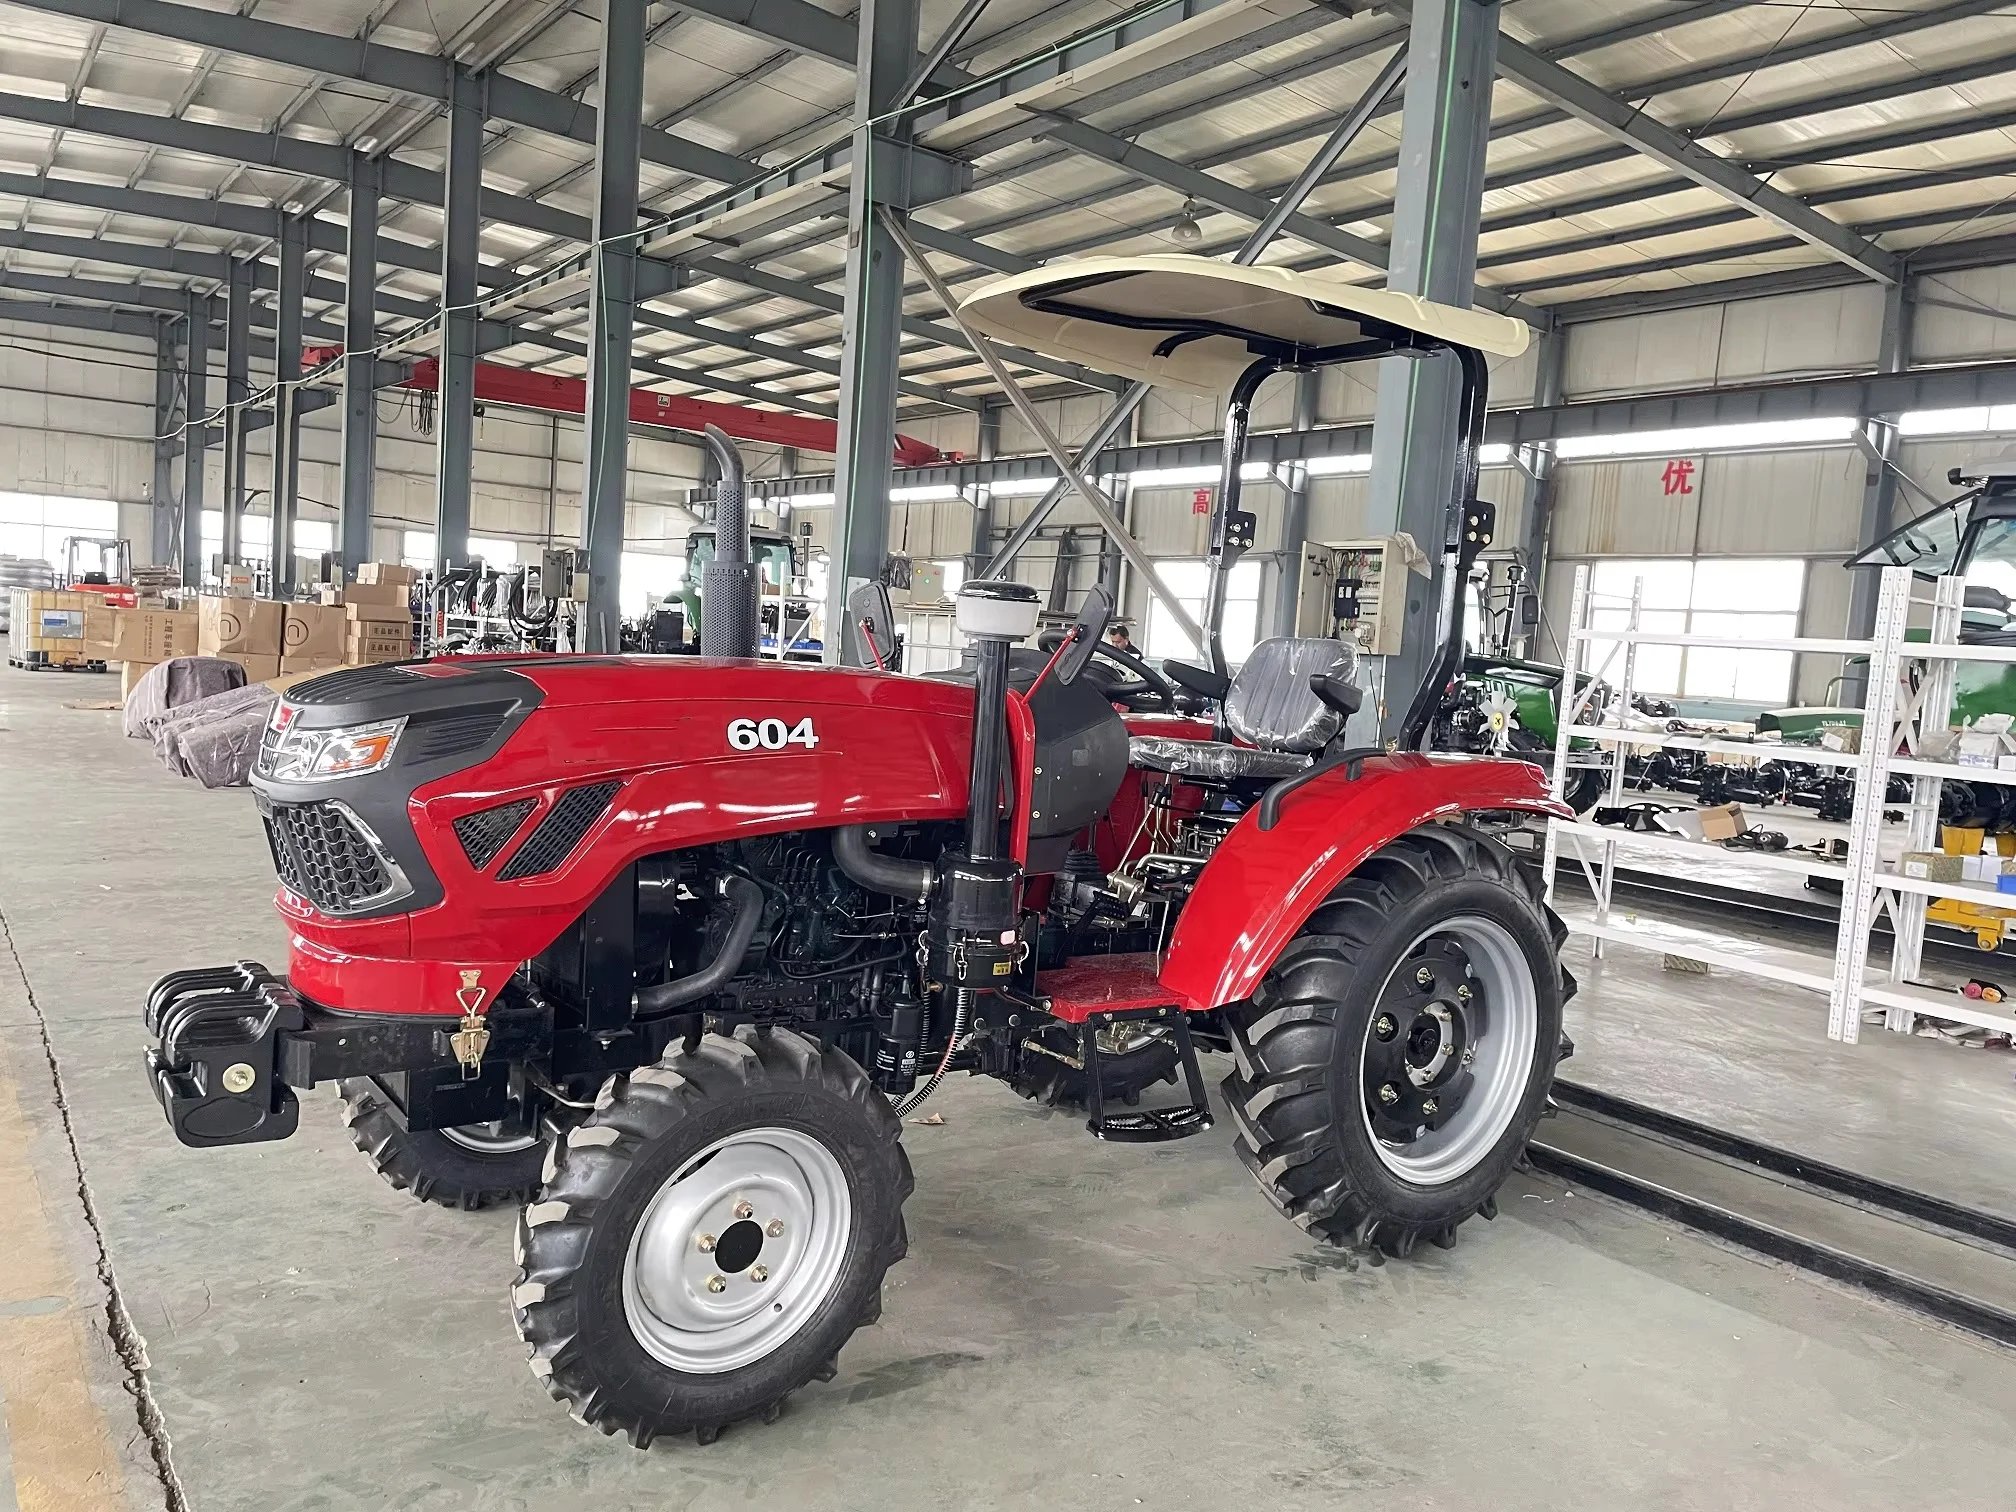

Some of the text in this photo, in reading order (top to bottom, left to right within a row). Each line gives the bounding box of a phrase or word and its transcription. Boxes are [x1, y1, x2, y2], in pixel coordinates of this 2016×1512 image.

[552, 378, 563, 390] 全
[1661, 460, 1694, 495] 优
[1193, 488, 1210, 514] 高
[727, 717, 820, 751] 604
